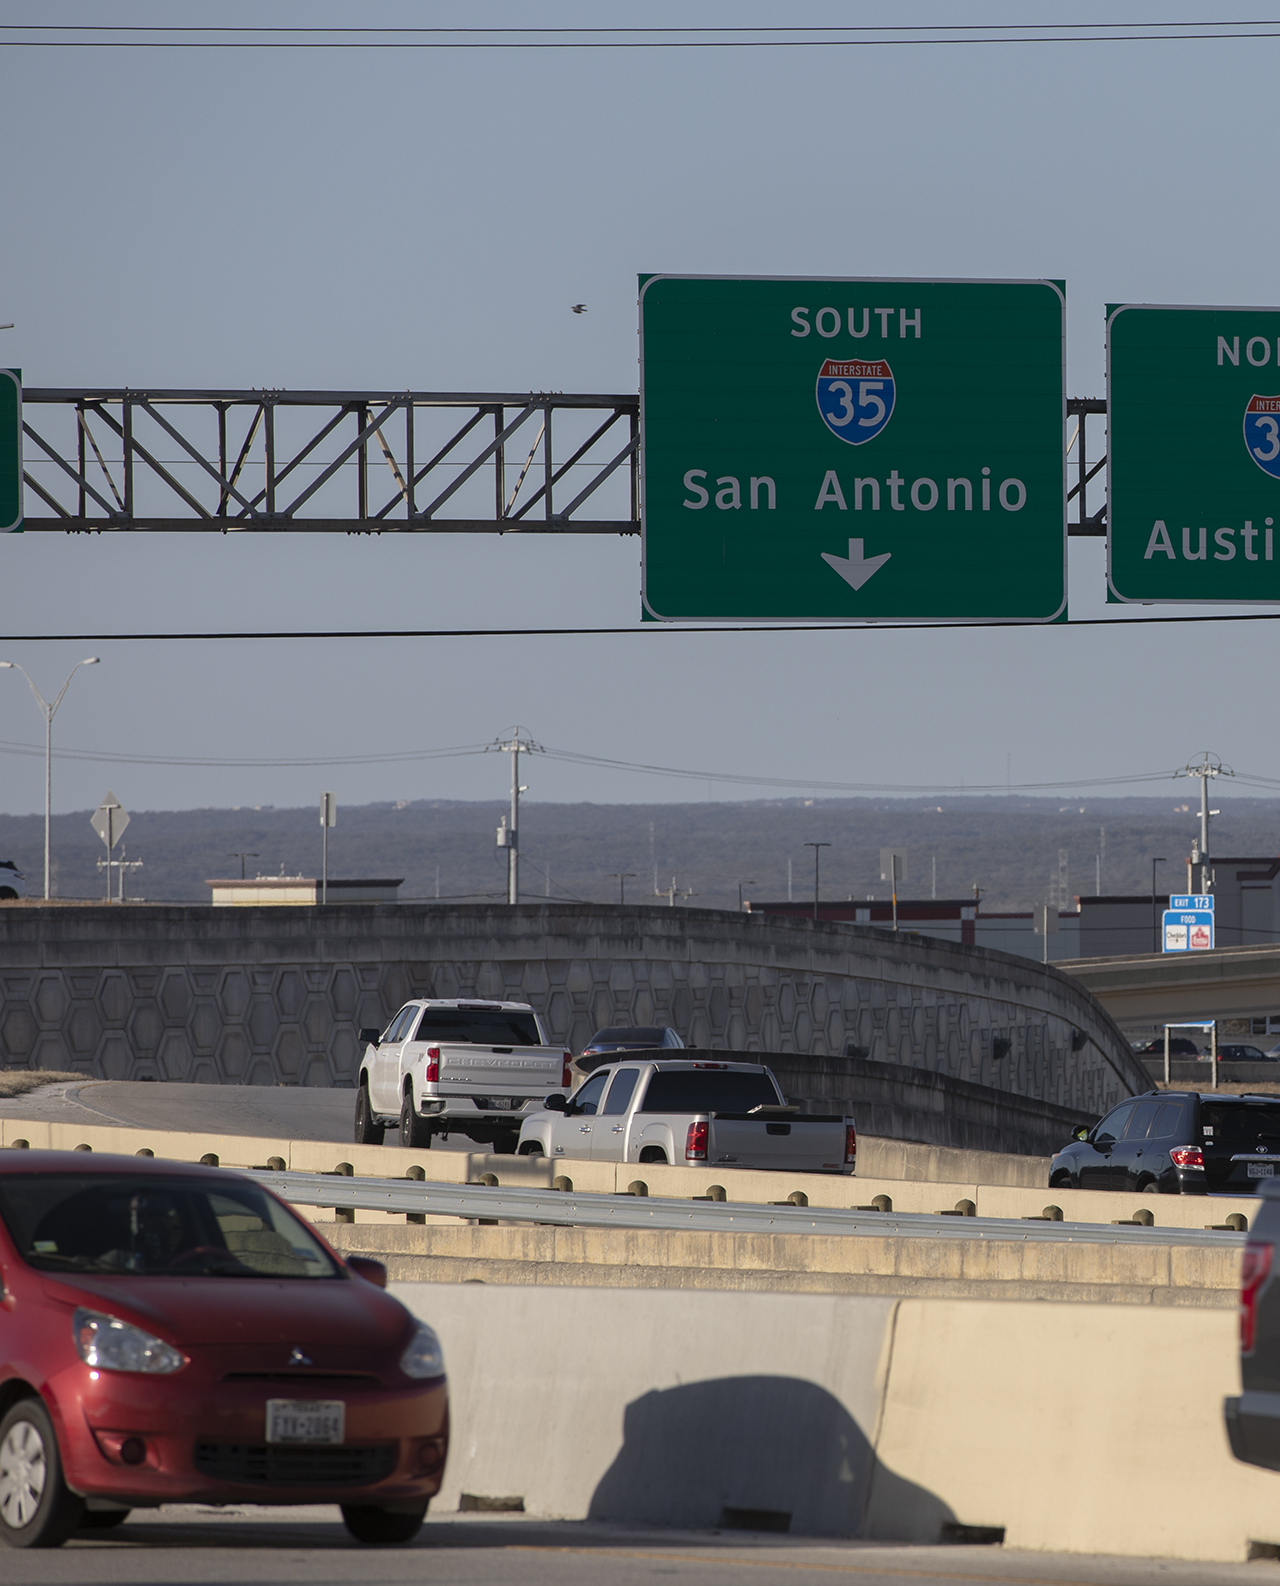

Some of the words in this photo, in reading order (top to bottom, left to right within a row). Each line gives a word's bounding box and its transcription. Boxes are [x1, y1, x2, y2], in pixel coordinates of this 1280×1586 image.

[791, 306, 921, 338] SOUTH
[828, 365, 883, 376] INTERSTATE
[826, 380, 886, 428] 35
[683, 469, 776, 510] San
[814, 466, 1027, 511] Antonio
[1174, 898, 1189, 907] EXIT
[1194, 897, 1210, 908] 173
[1180, 915, 1197, 924] FOOD
[447, 1057, 556, 1069] CHEVROLET
